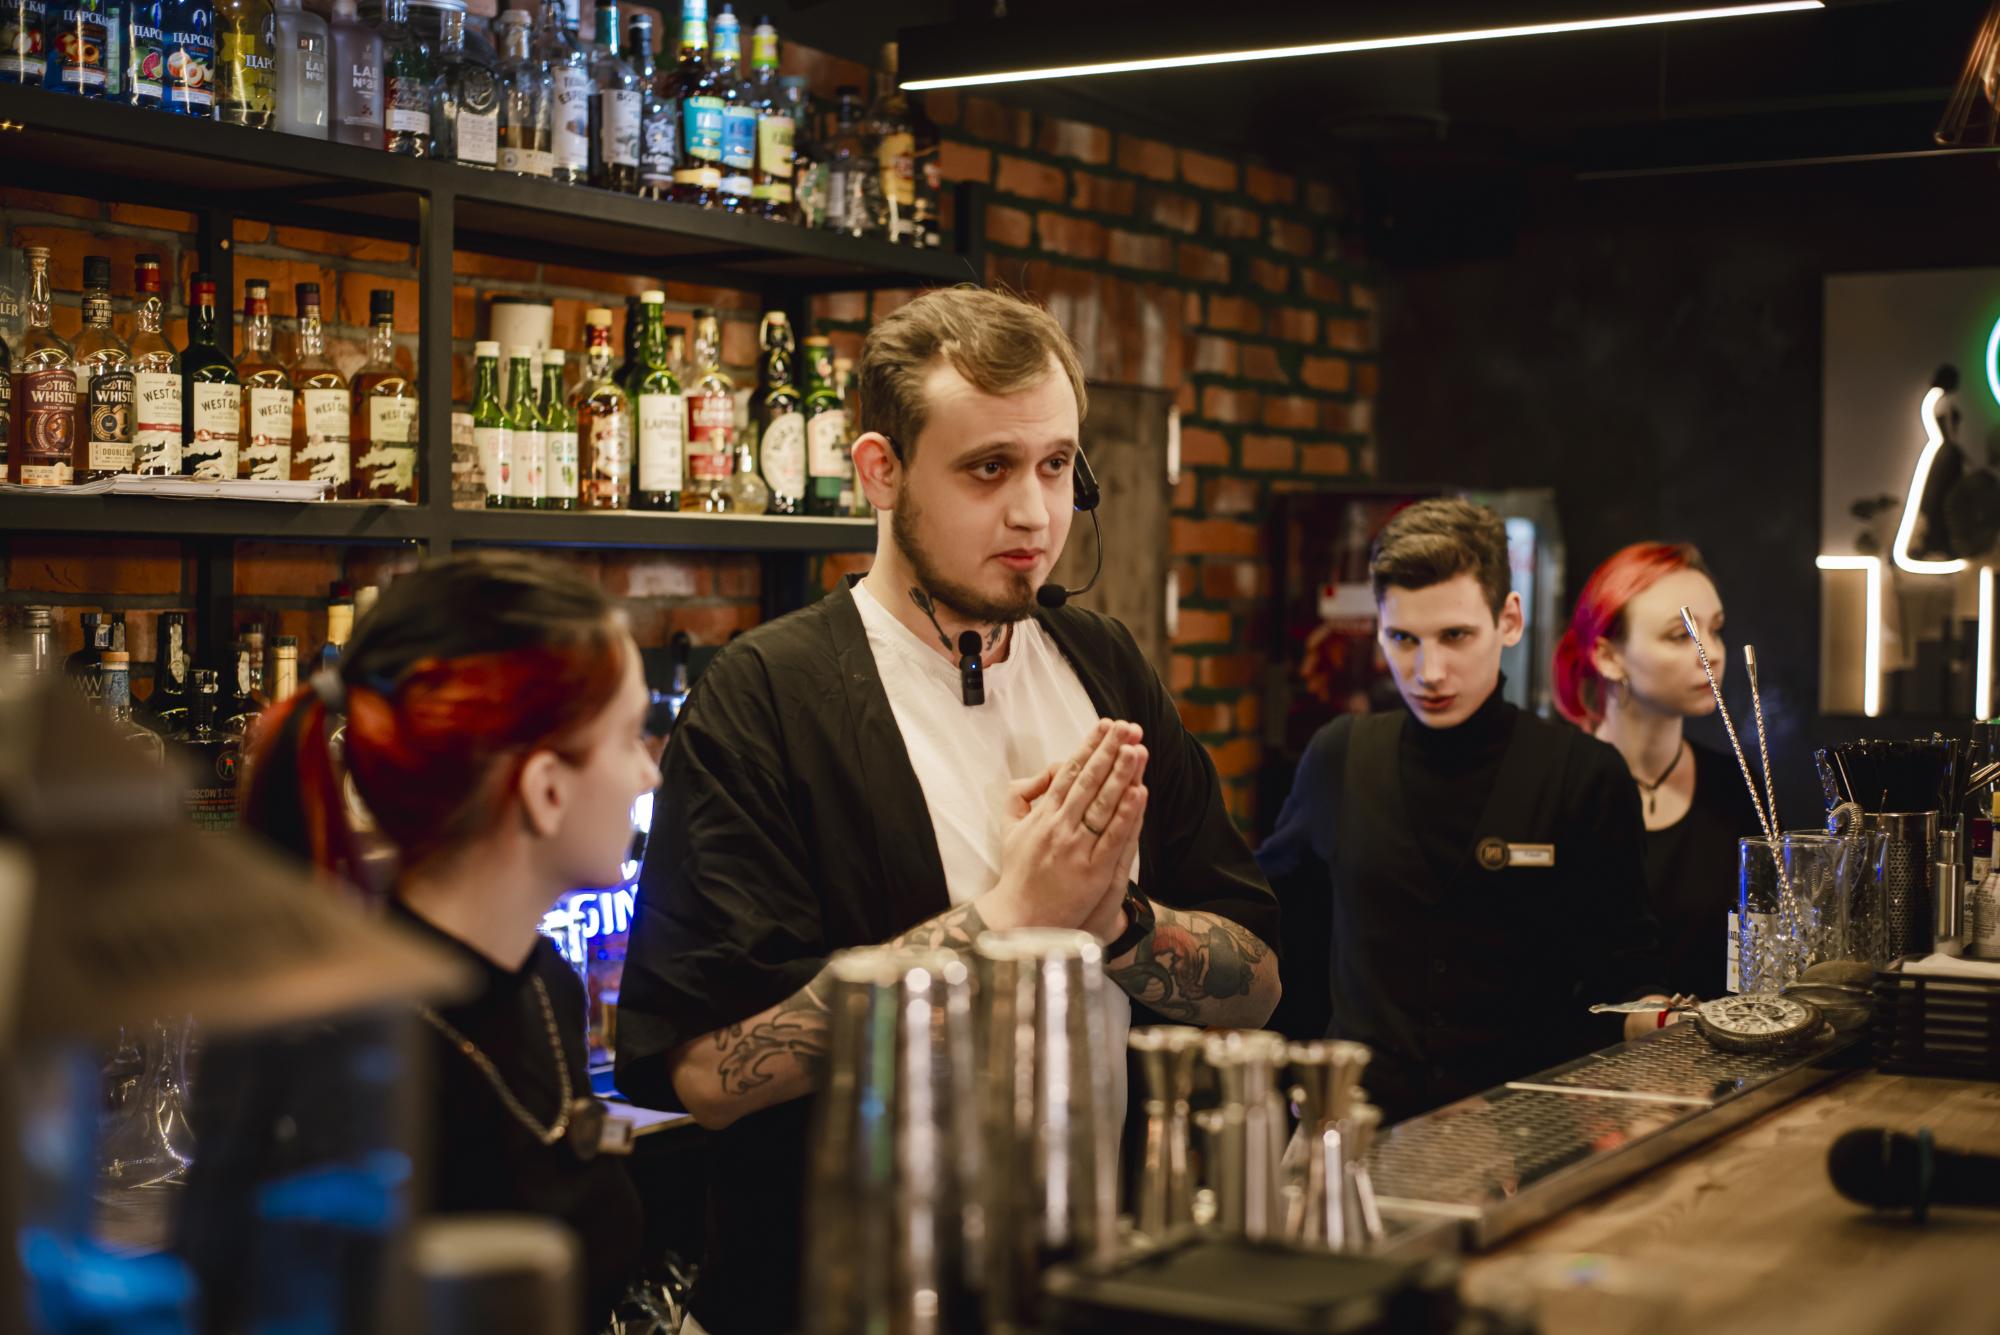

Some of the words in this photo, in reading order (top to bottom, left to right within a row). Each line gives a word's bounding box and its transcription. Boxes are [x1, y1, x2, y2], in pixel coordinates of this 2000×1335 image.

[143, 388, 169, 402] WEST
[201, 398, 226, 412] WEST
[257, 403, 282, 417] WEST
